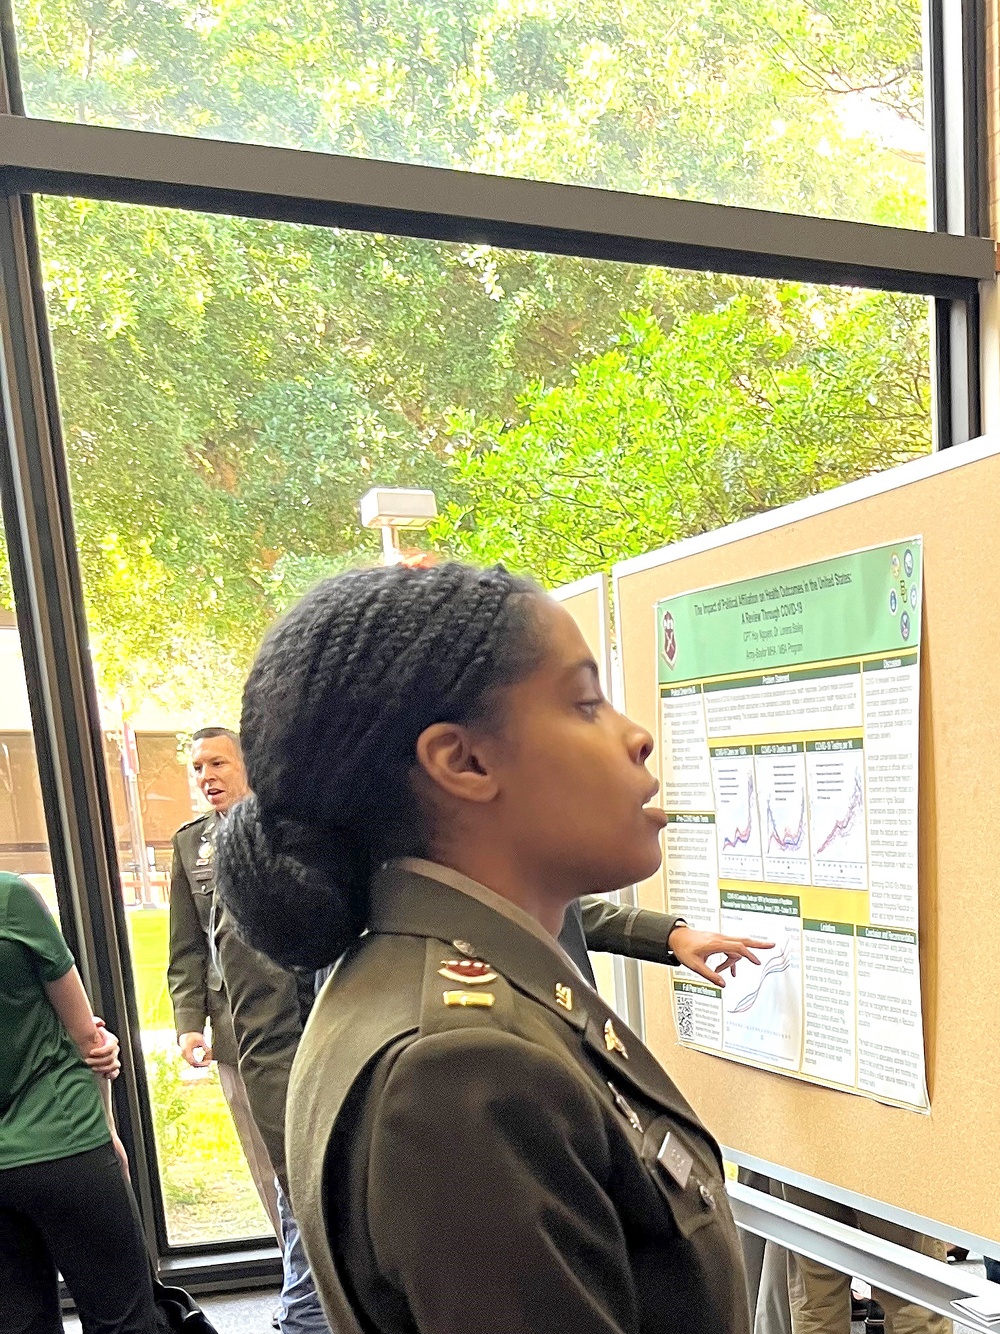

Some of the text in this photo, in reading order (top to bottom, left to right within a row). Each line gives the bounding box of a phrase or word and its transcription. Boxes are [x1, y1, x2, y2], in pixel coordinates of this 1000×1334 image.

[694, 604, 702, 616] The
[703, 602, 716, 615] Impact
[721, 596, 738, 610] Political
[765, 587, 779, 601] Health
[779, 580, 803, 598] Outcomes
[745, 610, 760, 624] Review
[761, 606, 779, 622] Through
[780, 601, 802, 617] COVID-19
